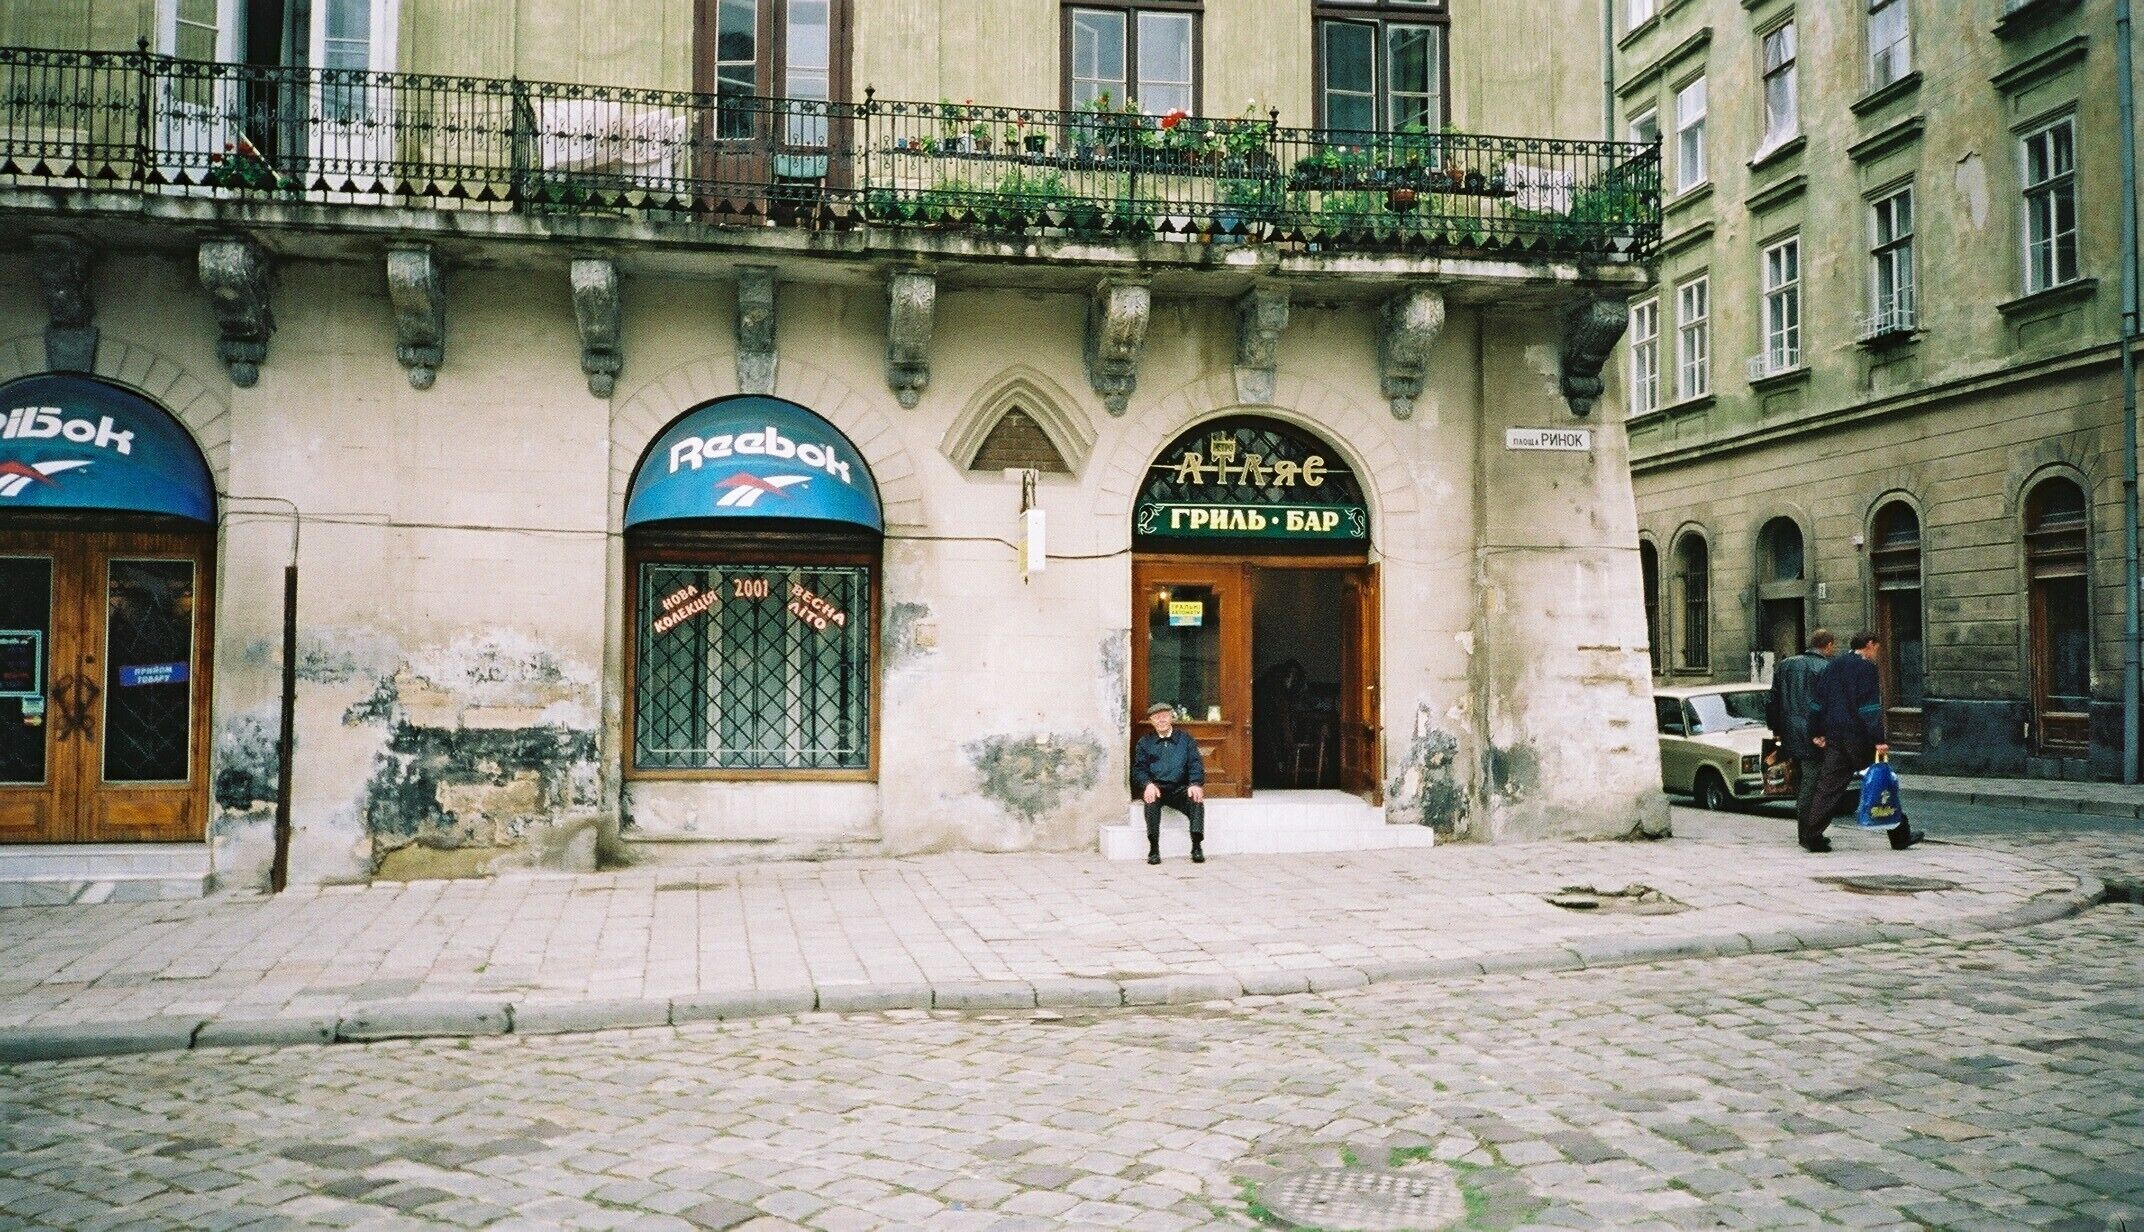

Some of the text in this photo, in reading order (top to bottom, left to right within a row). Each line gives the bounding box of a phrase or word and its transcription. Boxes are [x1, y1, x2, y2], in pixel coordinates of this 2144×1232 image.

[1541, 433, 1583, 447] РИНОК
[669, 426, 851, 484] Reebok
[1170, 508, 1340, 532] ГРИЛЬ БАР
[662, 584, 698, 611] НОВА
[733, 577, 770, 599] 2001
[653, 590, 719, 634] КОЛЕКЦІЯ
[787, 601, 828, 631] ЛІТО
[791, 582, 847, 627] ВЕСНА
